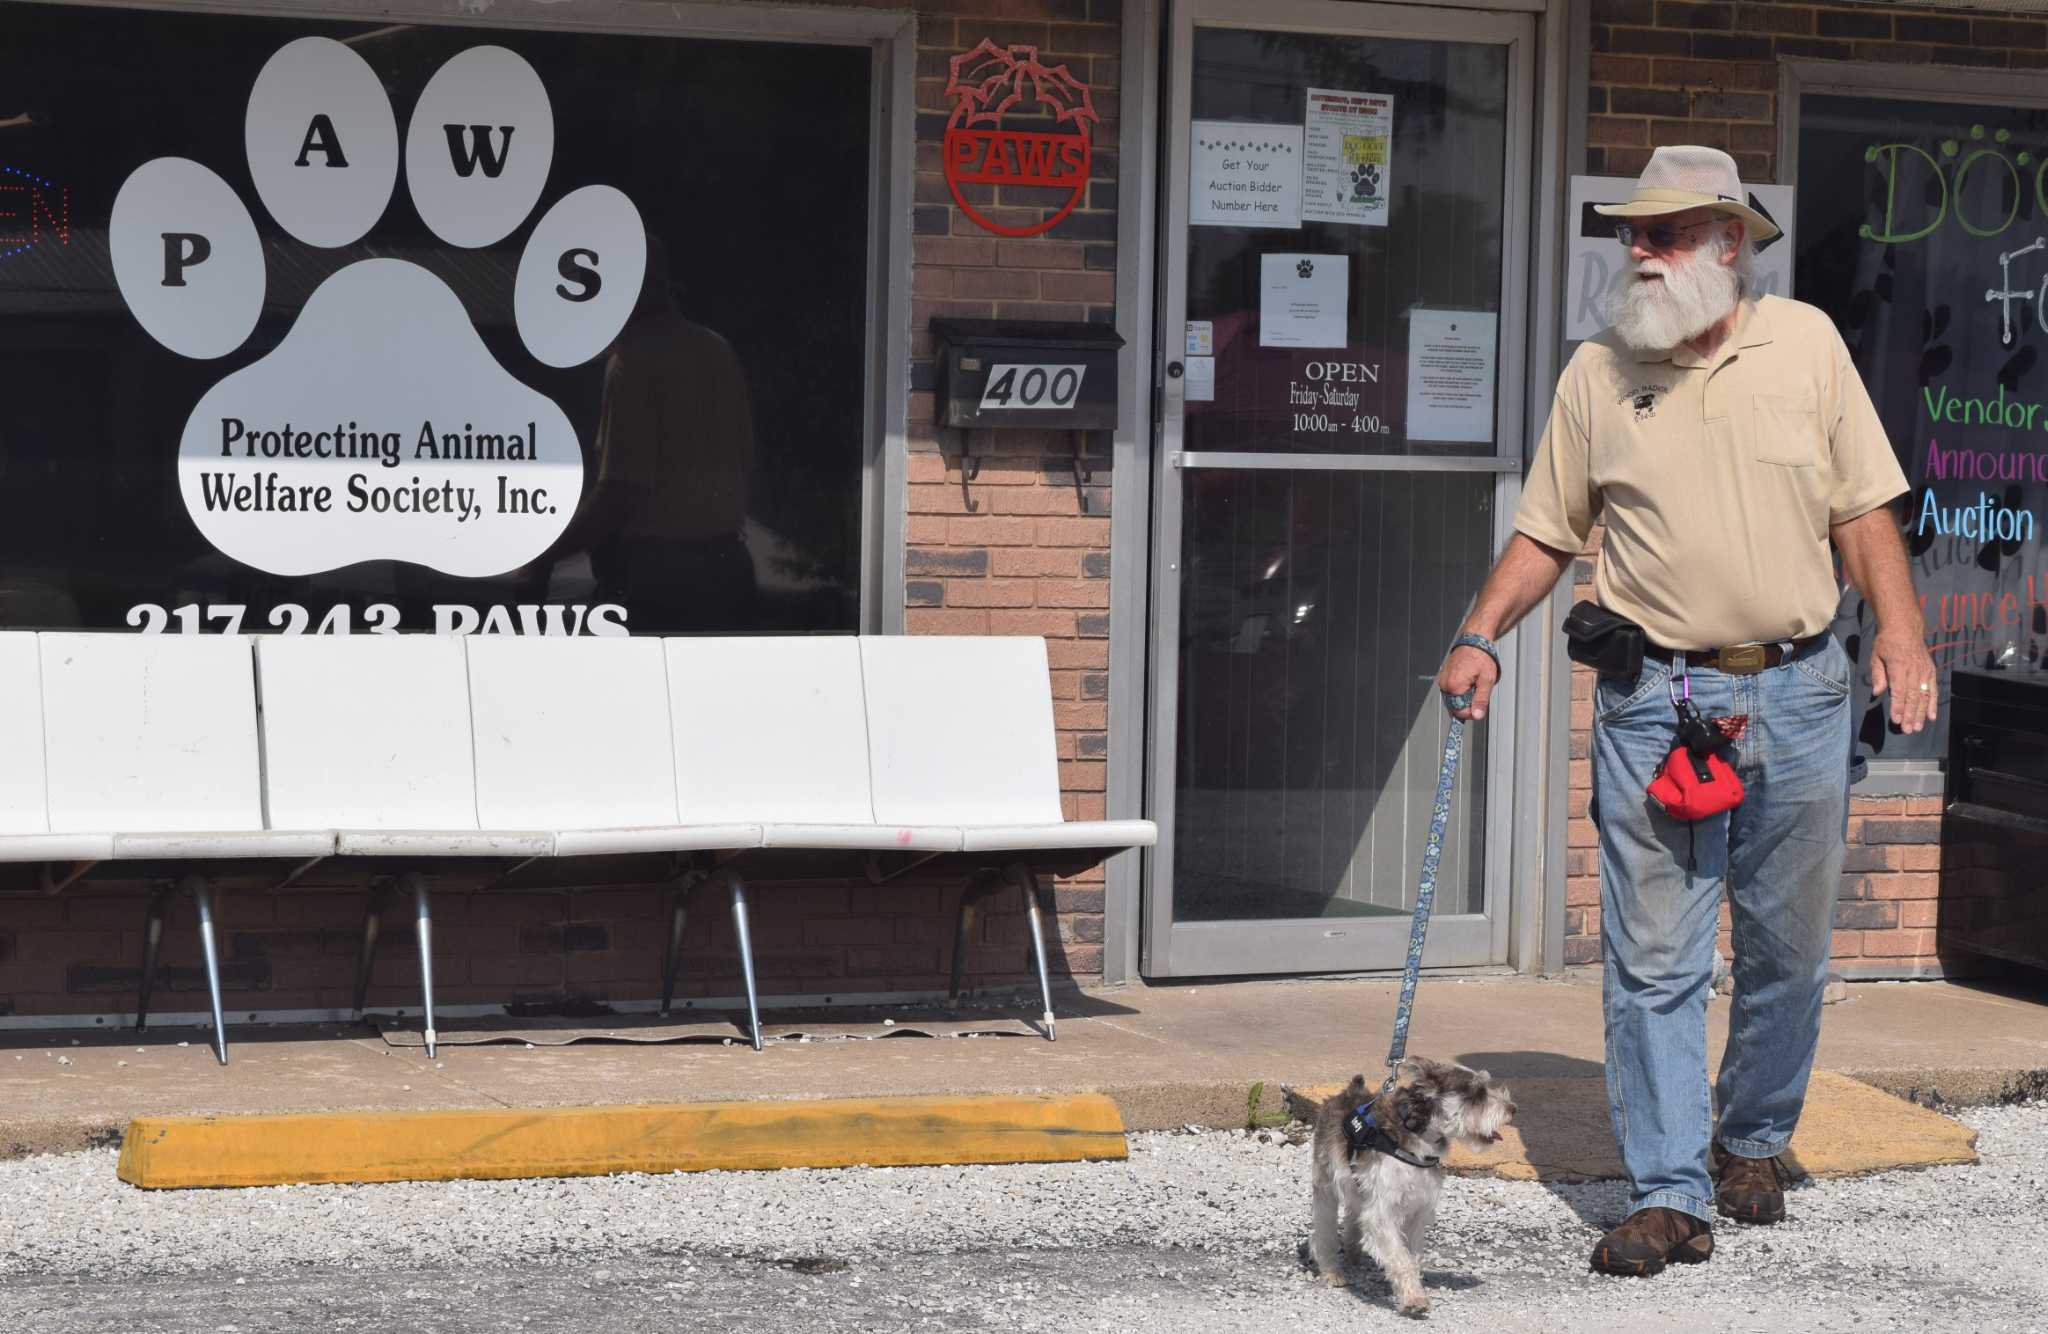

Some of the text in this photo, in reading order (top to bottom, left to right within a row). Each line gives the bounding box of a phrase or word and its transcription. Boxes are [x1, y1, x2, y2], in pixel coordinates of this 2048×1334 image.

[952, 133, 1085, 179] PAWS
[1222, 159, 1269, 171] Get Your
[1209, 180, 1282, 193] Auction Bidder
[1211, 200, 1279, 212] Number Here
[1859, 143, 2048, 243] DO
[986, 367, 1079, 406] 400
[1305, 361, 1380, 383] OPEN
[221, 417, 537, 468] Protecting Animal
[200, 472, 557, 523] Welfare Society, Inc.
[1918, 487, 2033, 544] Auction
